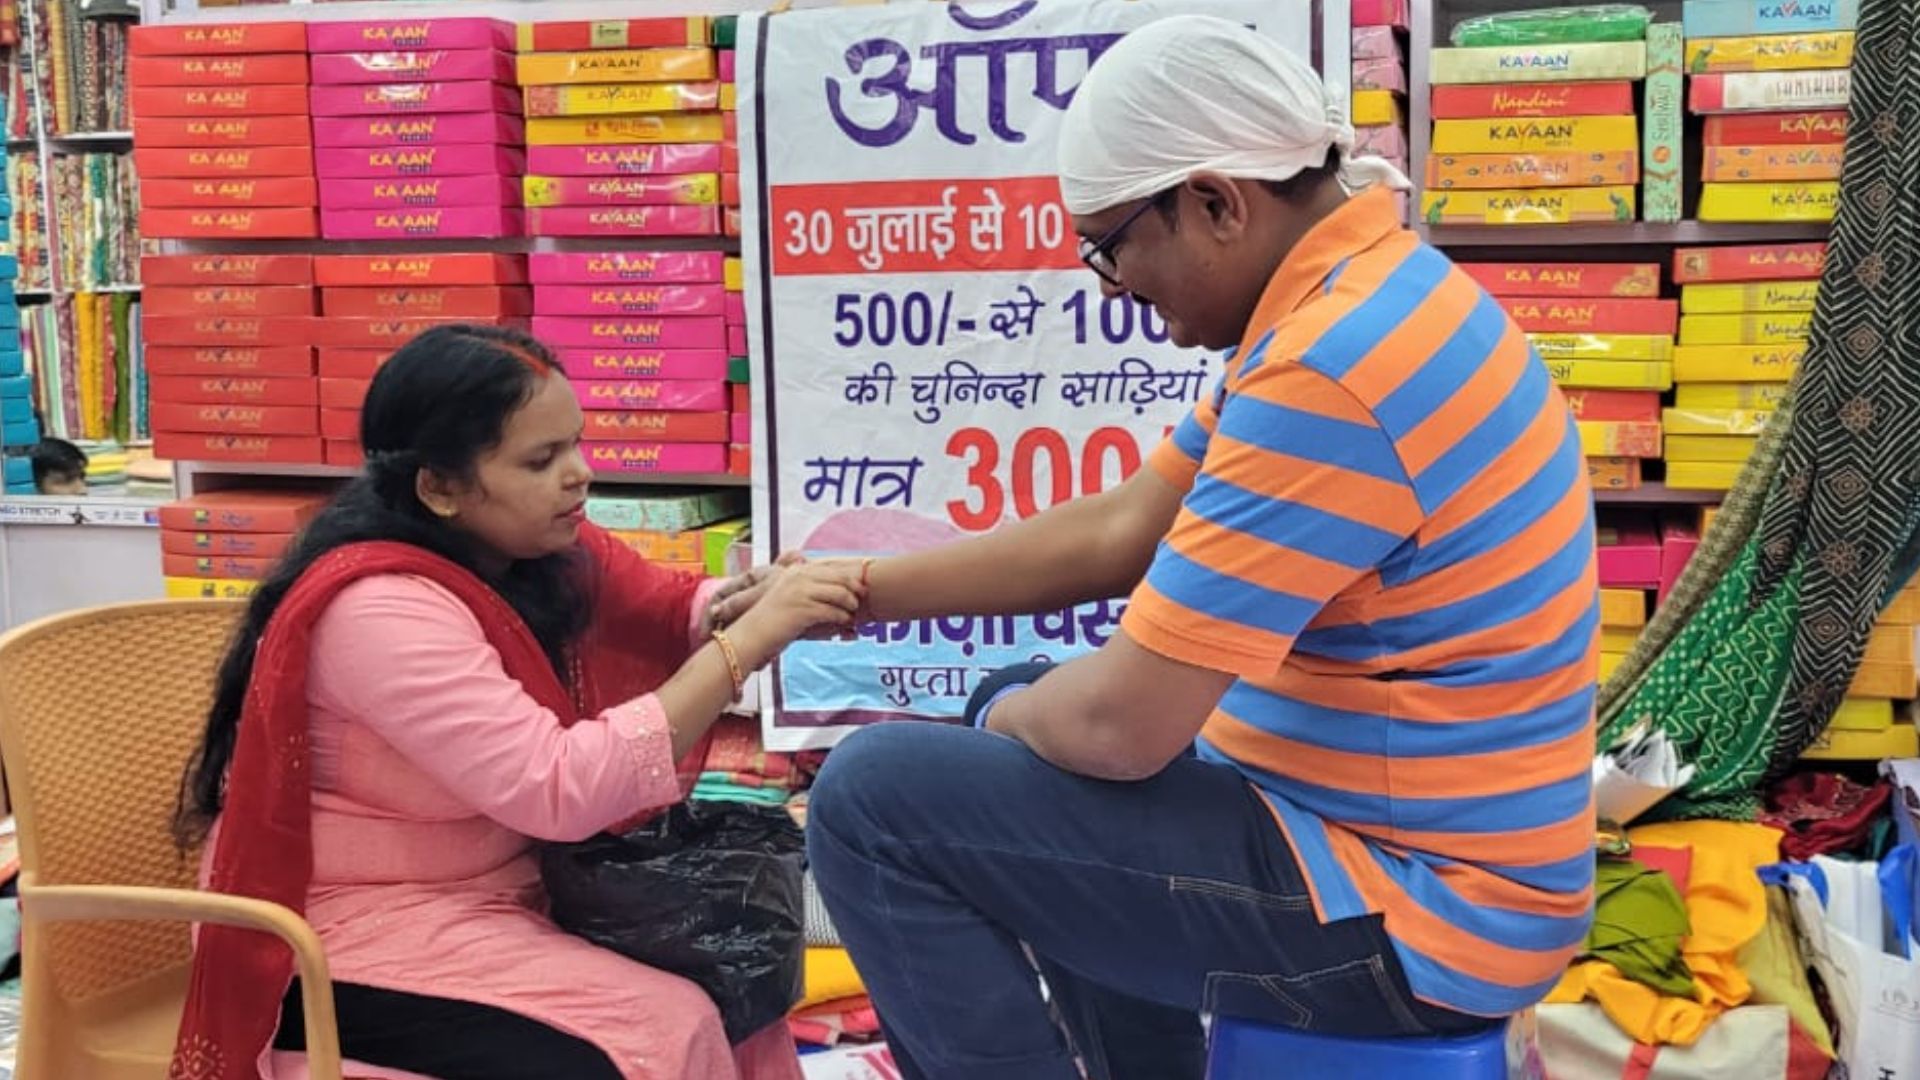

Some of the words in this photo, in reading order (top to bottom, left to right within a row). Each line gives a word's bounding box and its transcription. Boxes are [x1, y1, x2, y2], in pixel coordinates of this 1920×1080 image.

[1759, 3, 1832, 18] KAYAAN
[363, 23, 430, 39] KAAAN
[1757, 40, 1837, 56] KAYAAN
[579, 57, 643, 70] KAYAAN
[1499, 54, 1569, 69] KAYAAN
[1492, 90, 1571, 111] Nandini
[369, 119, 436, 136] KAAAN
[1489, 124, 1573, 141] KAYAAN
[369, 150, 436, 166] KAAAN
[1768, 151, 1841, 166] KAYAA
[1486, 159, 1569, 175] KAYAAN
[374, 181, 440, 197] KAAAN
[1488, 195, 1563, 209] KAYAAN
[375, 213, 442, 227] KAAAN
[784, 209, 833, 256] 30
[844, 186, 957, 269] जुलाई
[968, 188, 1006, 251] से
[1018, 203, 1065, 251] 10
[587, 259, 656, 272] KAAAN
[1505, 268, 1583, 282] KAAAN
[591, 289, 662, 303] KAAAN
[834, 290, 976, 347] 500/-
[990, 286, 1045, 339] से
[1513, 305, 1596, 320] KAAAN
[592, 322, 662, 336] KAAAN
[593, 353, 664, 368] KAAAN
[1752, 349, 1803, 366] KAYA
[590, 383, 661, 397] KAAAN
[845, 361, 896, 406] की
[911, 359, 1044, 424] चुनिन्दा
[592, 446, 662, 460] KAAAN
[803, 456, 924, 507] मात्र
[945, 426, 1176, 533] 300
[877, 666, 970, 707] गुप्ता
